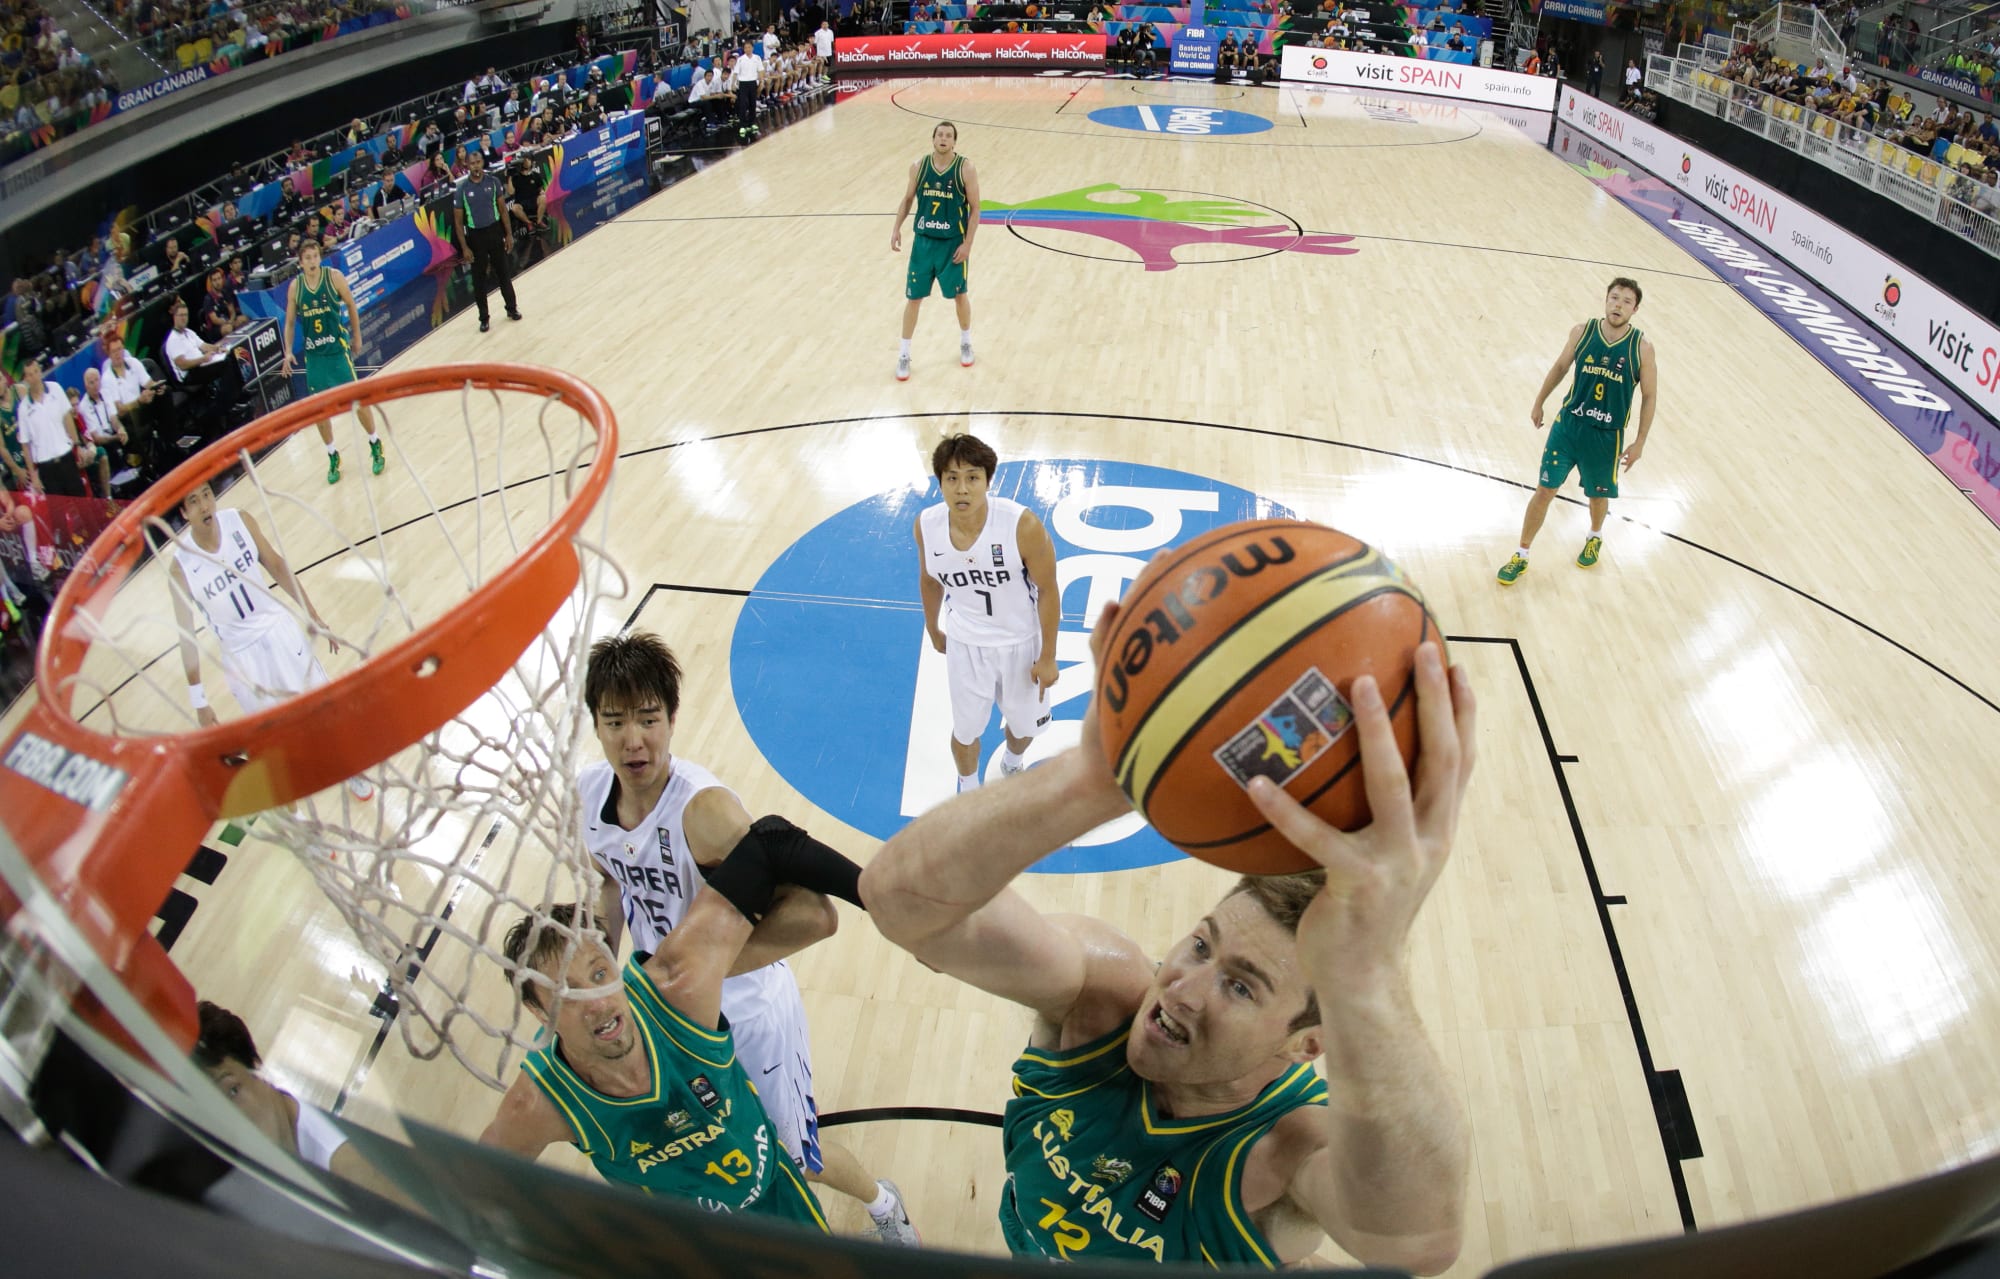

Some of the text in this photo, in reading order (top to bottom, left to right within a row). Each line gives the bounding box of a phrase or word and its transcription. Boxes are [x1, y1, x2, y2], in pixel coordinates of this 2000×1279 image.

[1544, 0, 1603, 19] GRAN CANARIA
[1186, 29, 1205, 38] FIBA
[1178, 44, 1211, 52] Basketball
[1178, 51, 1211, 61] World Cup
[1173, 61, 1215, 70] GRAN CANARIA
[118, 67, 206, 110] GRAN CANARIA
[1355, 63, 1532, 96] visit SPAIN spain.info
[1921, 70, 1976, 96] GRAN CANARIA
[1583, 107, 1598, 128] visit
[1597, 111, 1625, 142] SPAIN
[932, 202, 941, 215] 7
[1705, 174, 1729, 205] visit
[1729, 184, 1777, 234] SPAIN
[1792, 230, 1833, 265] spain.info
[314, 319, 323, 334] 5
[1667, 219, 1951, 412] GRAN CANARIA
[255, 327, 277, 352] FIBA
[1929, 319, 1974, 372] visit
[1581, 365, 1623, 384] AUSTRALIA
[1594, 383, 1605, 401] 9
[1585, 407, 1613, 424] airbnb
[203, 549, 254, 600] KOREA
[938, 570, 1011, 588] KOREA
[230, 583, 255, 619] 11
[974, 589, 993, 617] 7
[1105, 536, 1296, 714] molten
[4, 732, 126, 811] FIBA.COM
[594, 852, 683, 899] OREA
[704, 1148, 752, 1185] 13
[1144, 1189, 1167, 1212] FIBA
[1038, 1197, 1091, 1263] 12
